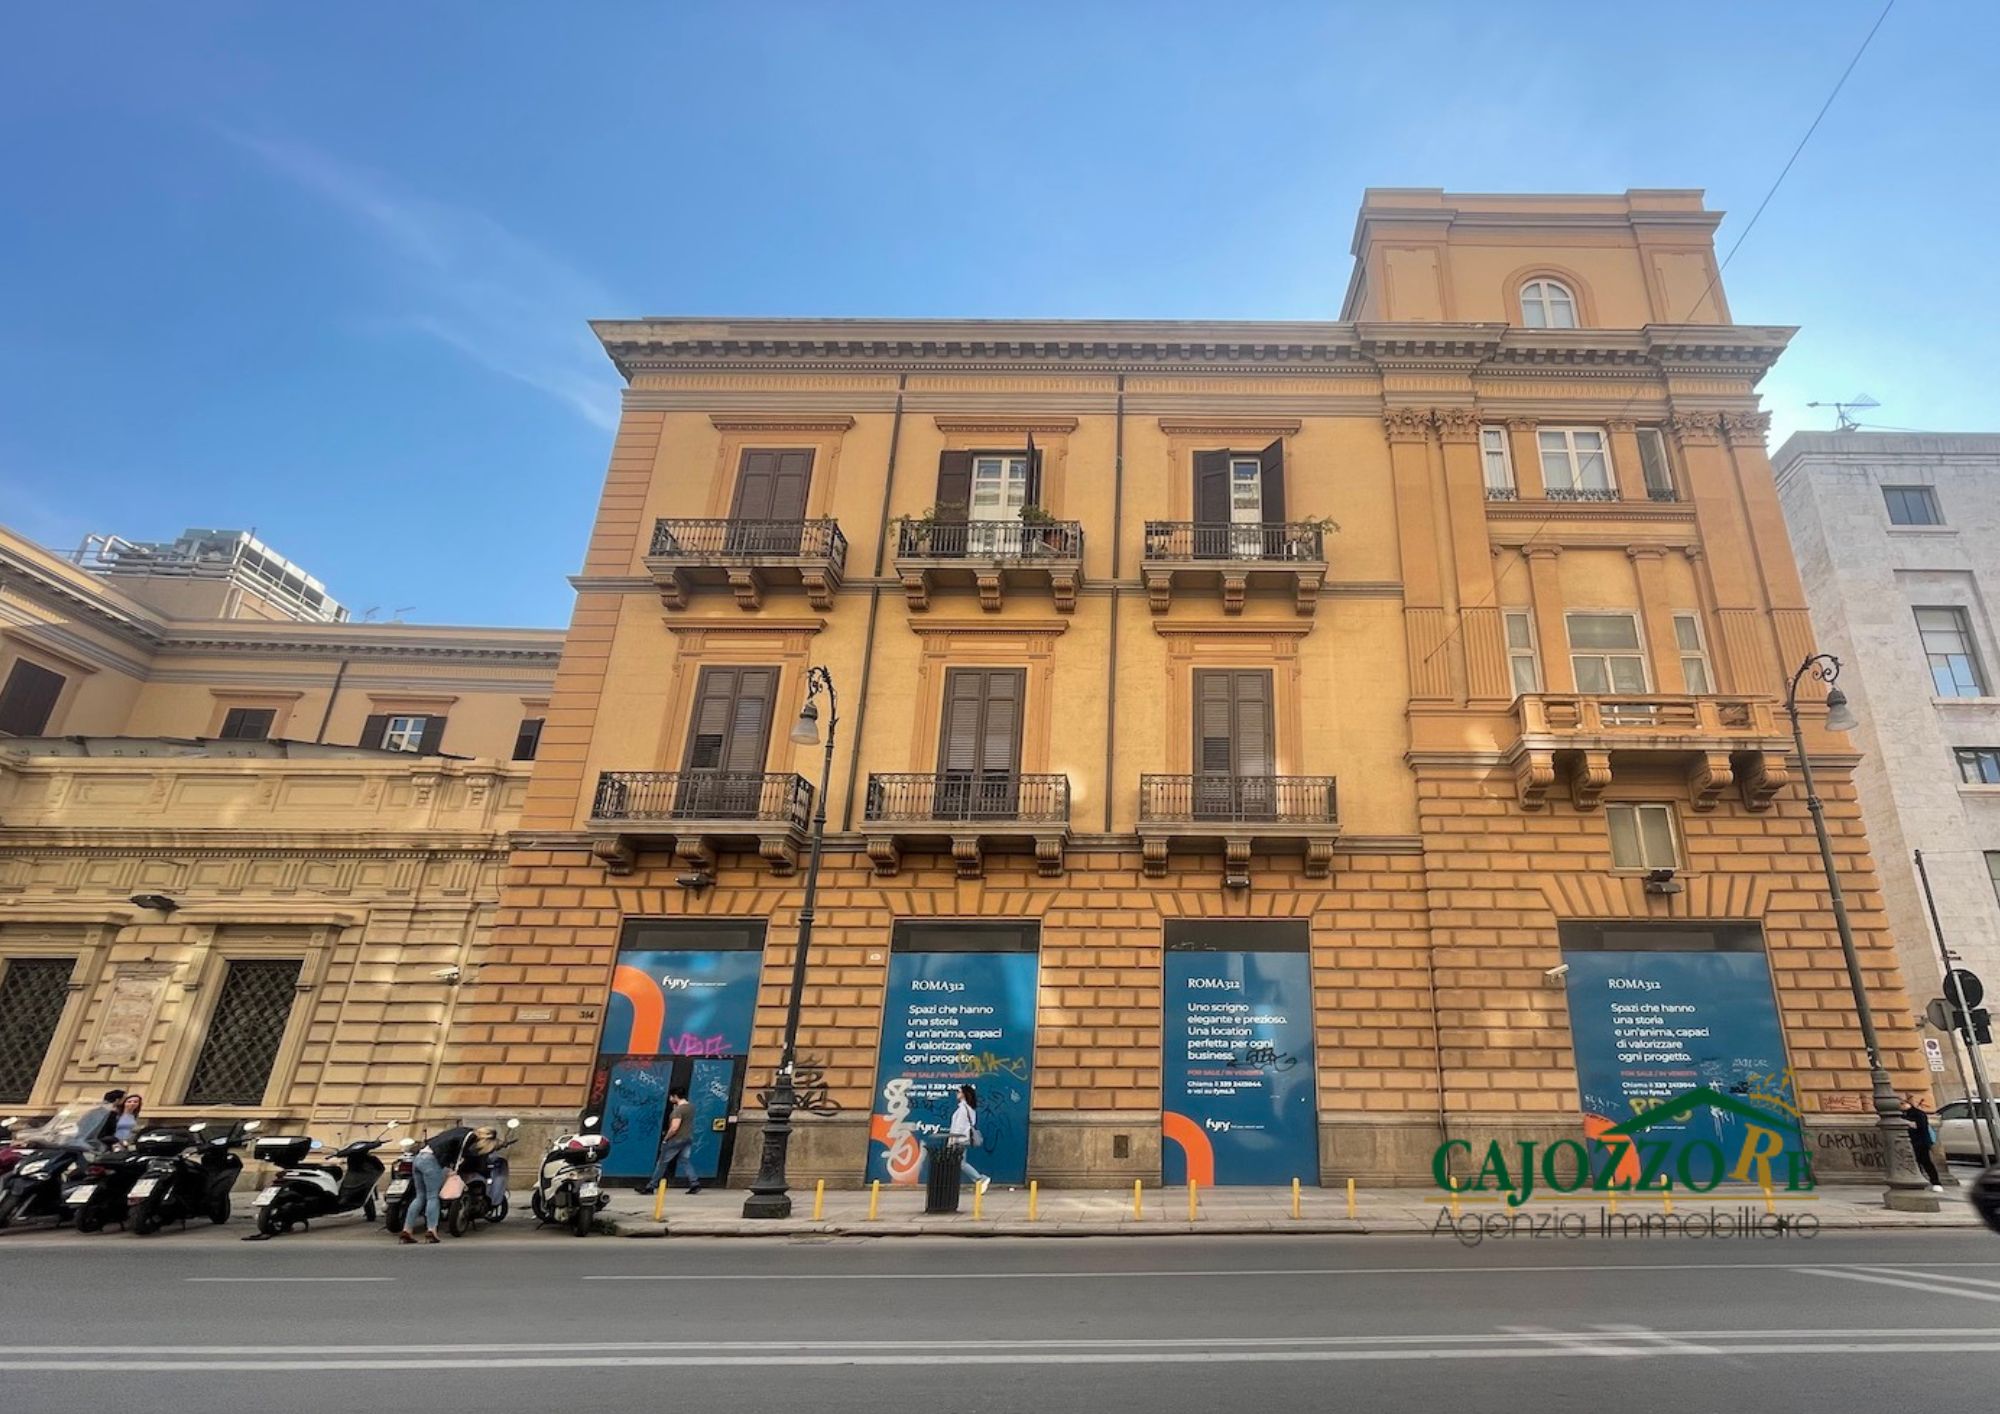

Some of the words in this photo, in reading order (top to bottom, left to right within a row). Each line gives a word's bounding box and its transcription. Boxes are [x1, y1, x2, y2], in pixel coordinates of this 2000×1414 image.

[911, 979, 965, 992] ROMA312
[1187, 978, 1240, 989] ROMA312
[1608, 979, 1661, 991] ROMA312
[909, 1004, 937, 1016] Spazi
[938, 1004, 958, 1014] che
[959, 1005, 994, 1014] hanno
[1187, 1003, 1210, 1012] Uno
[1211, 1002, 1249, 1014] scrigno
[1611, 1003, 1639, 1014] Spazi
[1640, 1003, 1660, 1013] che
[1661, 1003, 1696, 1013] hanno
[908, 1018, 928, 1026] una
[930, 1016, 959, 1026] storia
[1187, 1015, 1233, 1026] elegante
[1234, 1016, 1241, 1024] e
[1243, 1015, 1287, 1026] prezioso.
[1613, 1016, 1634, 1025] una
[1634, 1015, 1664, 1025] storia
[906, 1030, 914, 1038] e
[915, 1028, 967, 1039] un'anima,
[967, 1028, 1002, 1040] capaci
[1187, 1027, 1210, 1036] Una
[1211, 1027, 1252, 1036] location
[1614, 1028, 1622, 1036] e
[1623, 1027, 1675, 1038] un'anima,
[1676, 1027, 1710, 1039] capaci
[905, 1041, 916, 1051] di
[917, 1041, 972, 1051] valorizzare
[1187, 1038, 1229, 1050] perfetta
[1231, 1040, 1249, 1050] per
[1250, 1038, 1274, 1050] ogni
[1616, 1040, 1627, 1049] di
[1628, 1039, 1683, 1049] valorizzare
[904, 1053, 928, 1064] ogni
[1187, 1050, 1235, 1061] business.
[1618, 1051, 1642, 1063] ogni
[1644, 1051, 1692, 1063] progetto.
